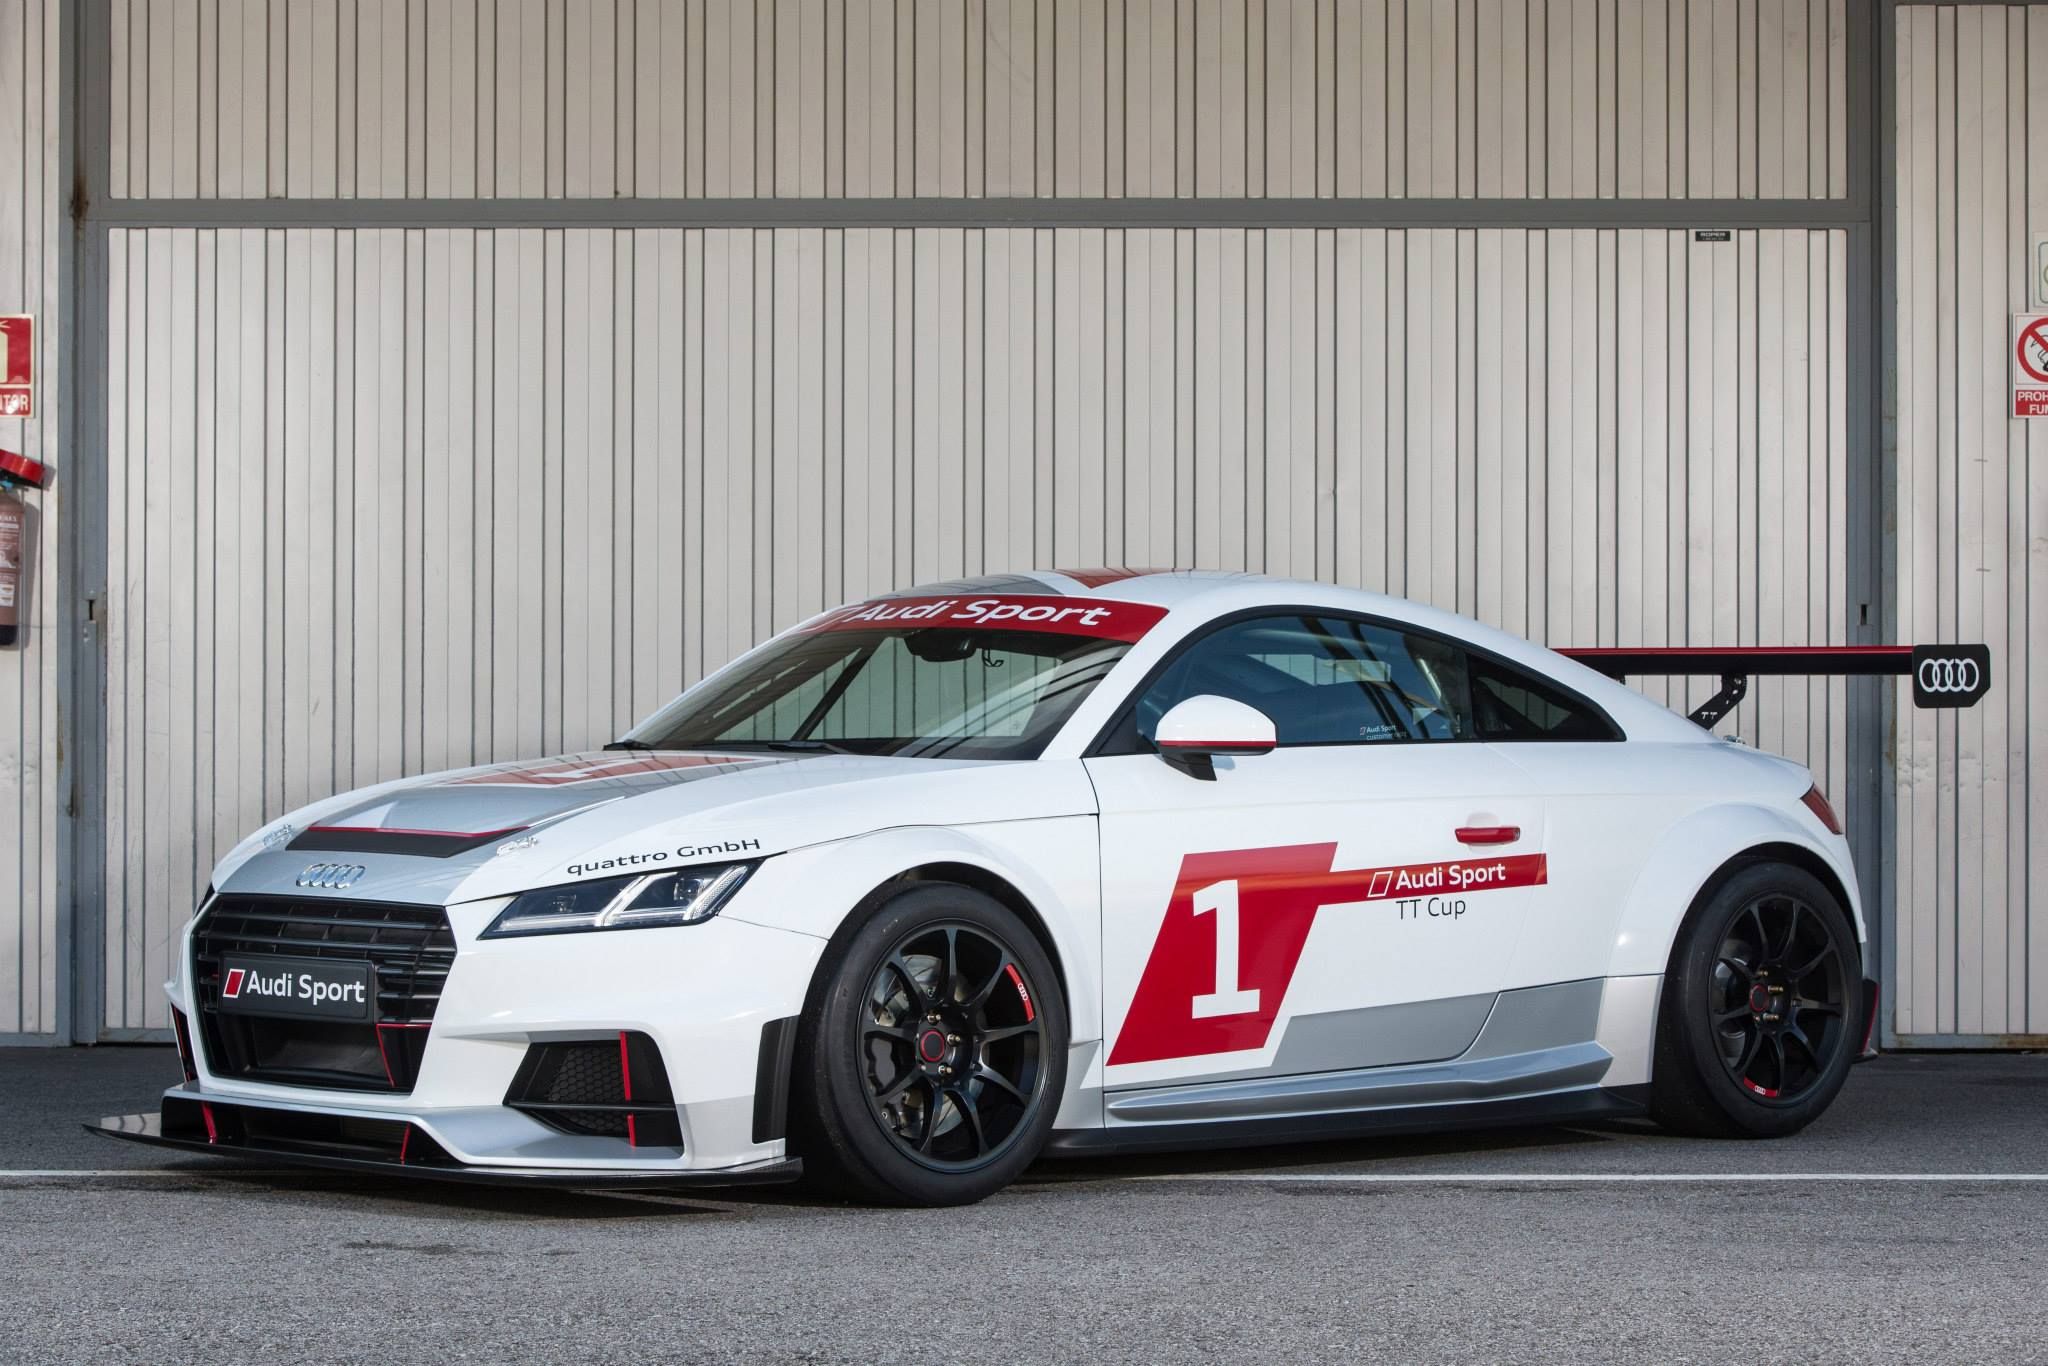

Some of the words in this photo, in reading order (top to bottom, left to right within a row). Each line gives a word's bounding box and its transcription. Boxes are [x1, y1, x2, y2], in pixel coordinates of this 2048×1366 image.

[851, 600, 957, 621] Audi
[951, 600, 1111, 626] Sport
[1381, 724, 1396, 733] Sport
[1701, 711, 1718, 720] TT
[567, 852, 668, 876] quattro
[677, 839, 760, 857] GmbH
[1395, 867, 1443, 890] Audi
[1449, 863, 1506, 889] Sport
[1396, 898, 1421, 920] TT
[1427, 897, 1466, 920] Cup
[1192, 879, 1260, 1020] 1
[246, 970, 292, 997] Audi
[298, 974, 365, 1006] Sport
